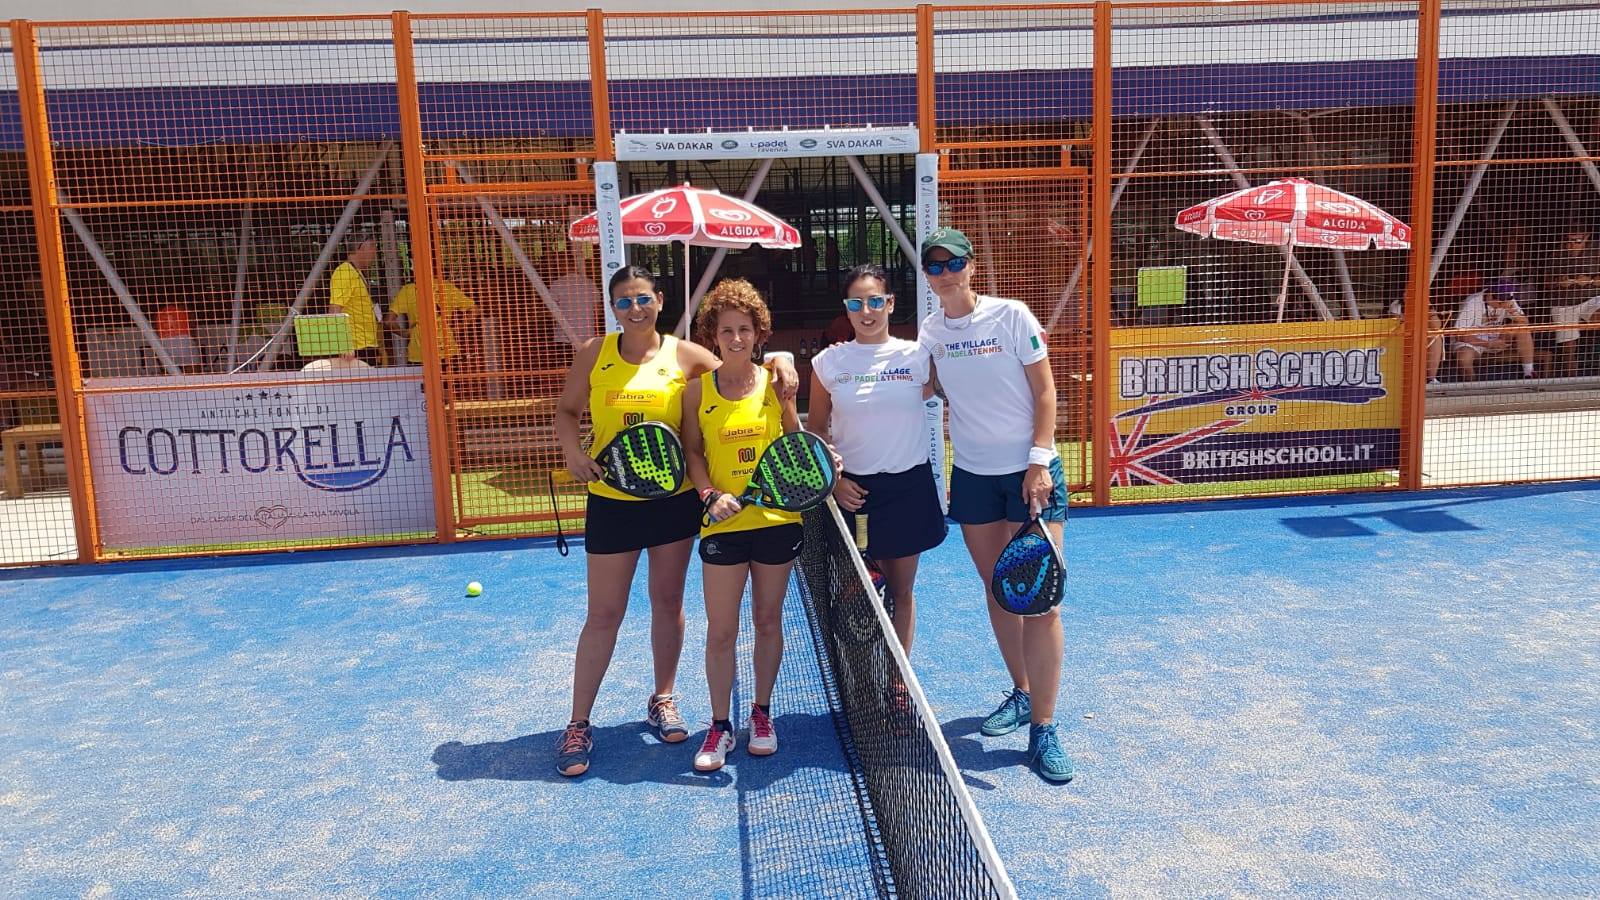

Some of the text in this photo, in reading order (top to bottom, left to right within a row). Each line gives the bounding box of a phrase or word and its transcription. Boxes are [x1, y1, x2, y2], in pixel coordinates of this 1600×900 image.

[655, 142, 675, 151] SVA
[677, 142, 713, 151] DAKAR
[826, 140, 846, 149] SVA
[848, 139, 883, 148] DAKAR
[1322, 219, 1367, 231] ALGIDA
[720, 226, 760, 237] ALGIDA
[945, 337, 998, 351] THE VILLAGE
[1120, 349, 1382, 398] BRITISH SCHOOL
[612, 392, 645, 400] Jabra
[200, 405, 330, 420] ANTICHE FONTI DI
[1225, 404, 1278, 416] GROUP
[724, 427, 754, 437] Jabra
[118, 415, 416, 493] COTTORELLA
[1182, 443, 1376, 470] BRITISHSCHOOL.IT
